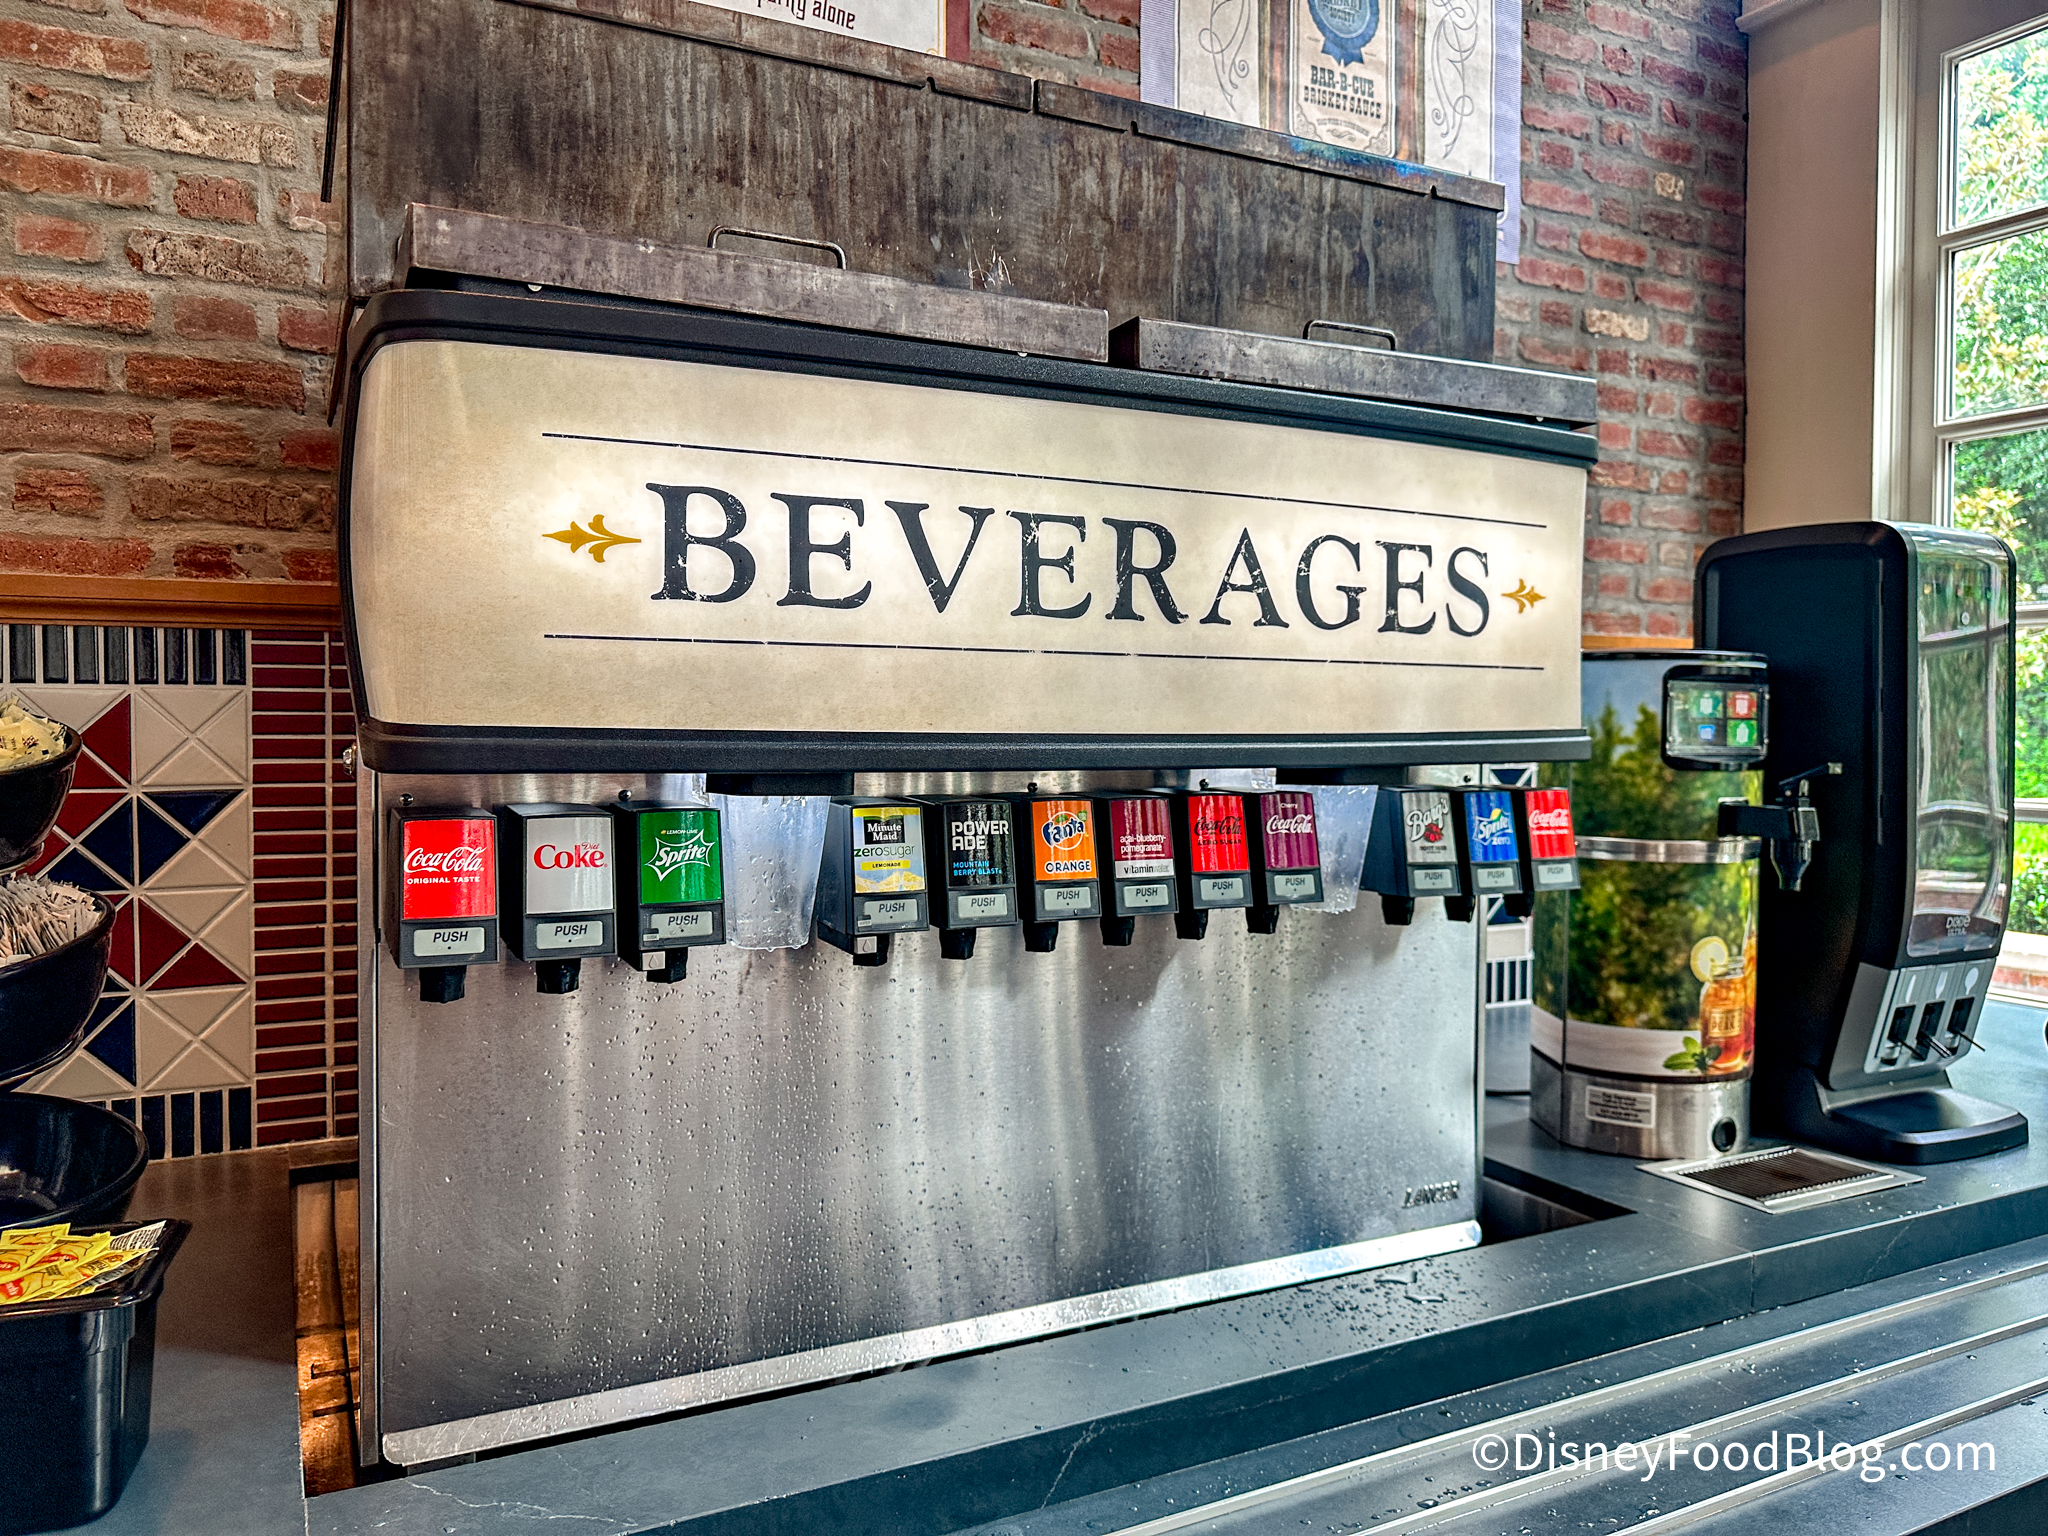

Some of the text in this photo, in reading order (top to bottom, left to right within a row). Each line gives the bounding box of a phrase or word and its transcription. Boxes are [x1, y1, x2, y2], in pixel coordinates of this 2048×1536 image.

[812, 0, 856, 30] alone
[1310, 64, 1374, 98] BAR-B-CUE
[1303, 86, 1381, 119] BRISKET SAUCE
[645, 482, 1491, 638] BEVERAGES
[1266, 813, 1314, 835] Coca-Cola
[1405, 796, 1450, 842] Barq's
[1528, 808, 1570, 828] Coca-Cola
[866, 822, 903, 834] Minute
[951, 820, 1010, 836] POWER
[1042, 817, 1086, 847] Fanta
[1194, 815, 1243, 836] Coca-Cola
[1477, 815, 1509, 840] Sprite
[872, 831, 898, 842] Maid
[952, 835, 987, 851] ADE
[581, 841, 600, 850] Diet
[1120, 843, 1163, 855] pomegranate
[403, 846, 487, 873] Coca-Cola
[533, 844, 605, 870] Coke
[654, 843, 707, 868] Sprite
[872, 861, 902, 869] LEMONADE
[953, 860, 990, 869] MOUNTAIN
[1045, 860, 1092, 873] ORANGE
[953, 868, 977, 877] BERRY
[1424, 871, 1443, 881] PUSH
[1486, 870, 1505, 880] PUSH
[406, 876, 480, 885] ORIGINAL TASTE
[1211, 880, 1234, 891] PUSH
[1285, 877, 1306, 887] PUSH
[1056, 890, 1080, 901] PUSH
[1135, 887, 1158, 898] PUSH
[878, 902, 906, 914] PUSH
[970, 897, 996, 908] PUSH
[667, 914, 699, 927] PUSH
[432, 930, 469, 944] PUSH
[554, 924, 588, 937] PUSH
